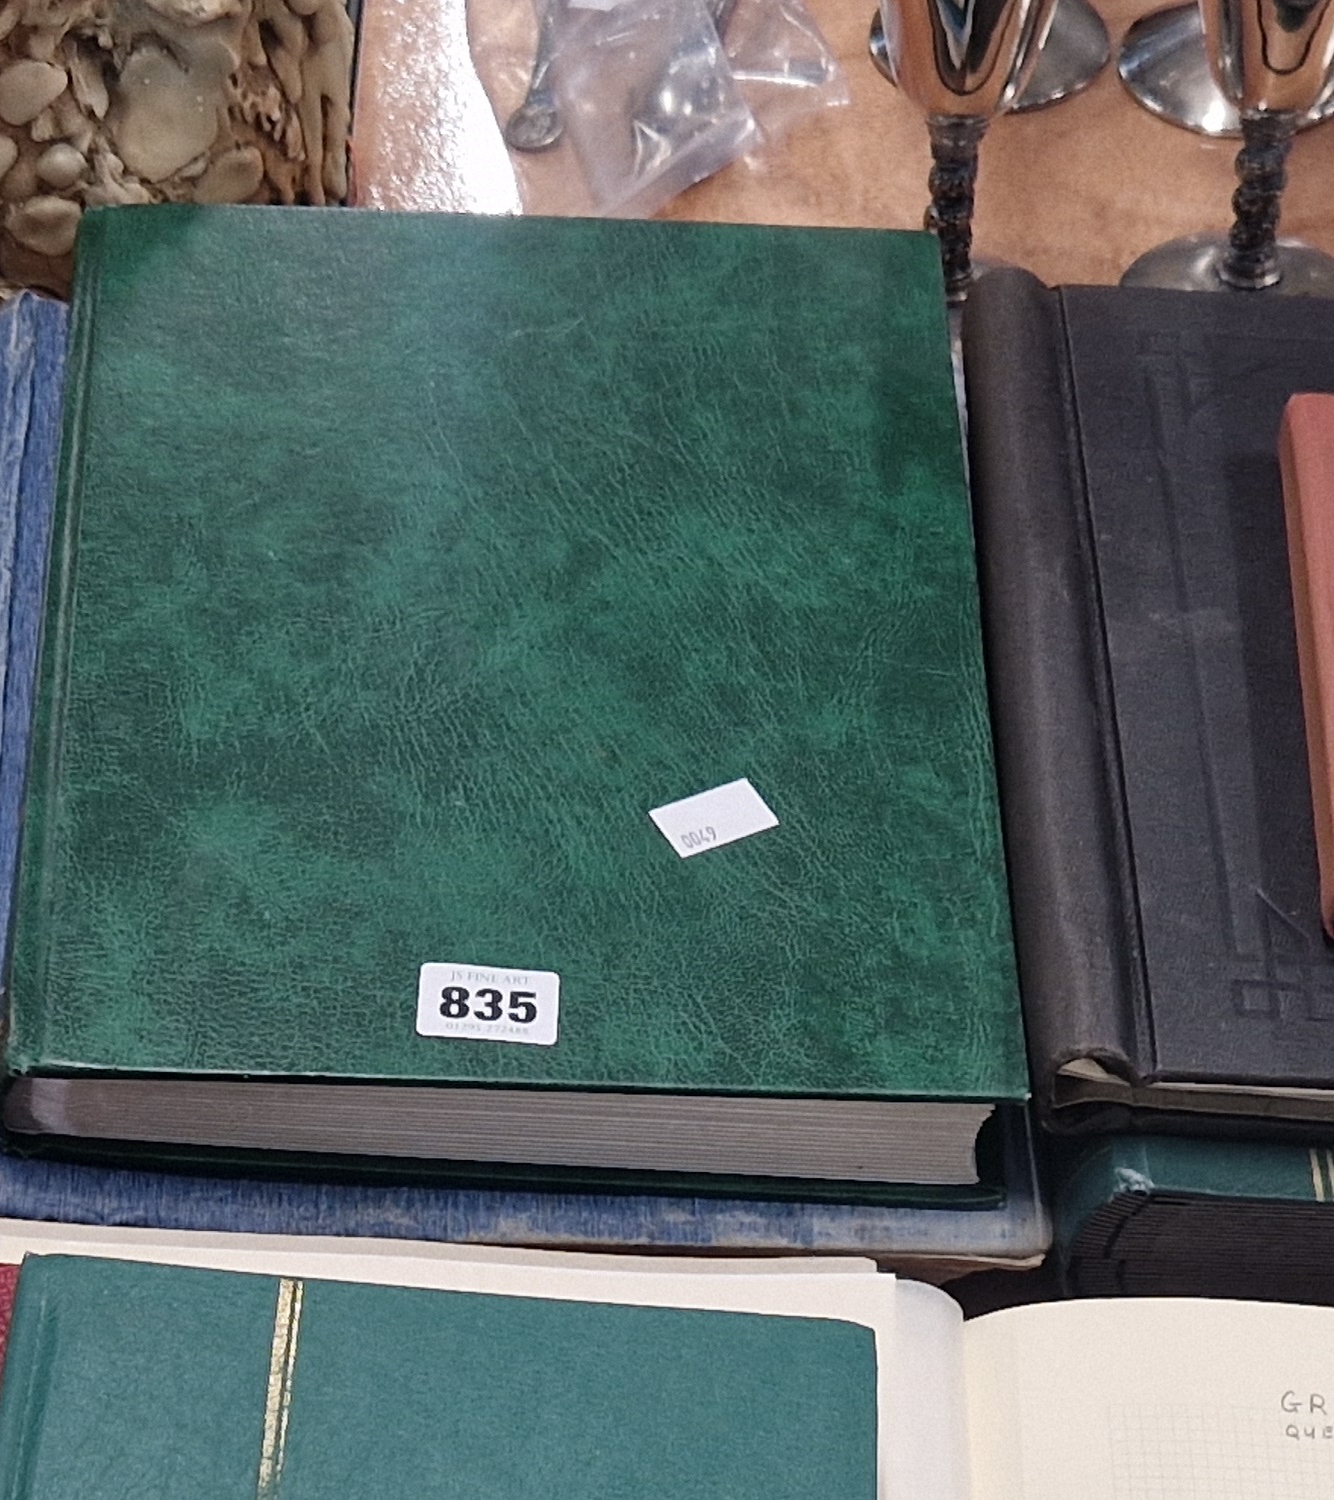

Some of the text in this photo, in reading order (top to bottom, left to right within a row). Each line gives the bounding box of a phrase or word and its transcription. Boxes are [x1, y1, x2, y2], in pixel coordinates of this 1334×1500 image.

[680, 826, 717, 849] 0049
[450, 970, 530, 986] JS FINE ART
[439, 986, 538, 1024] 835
